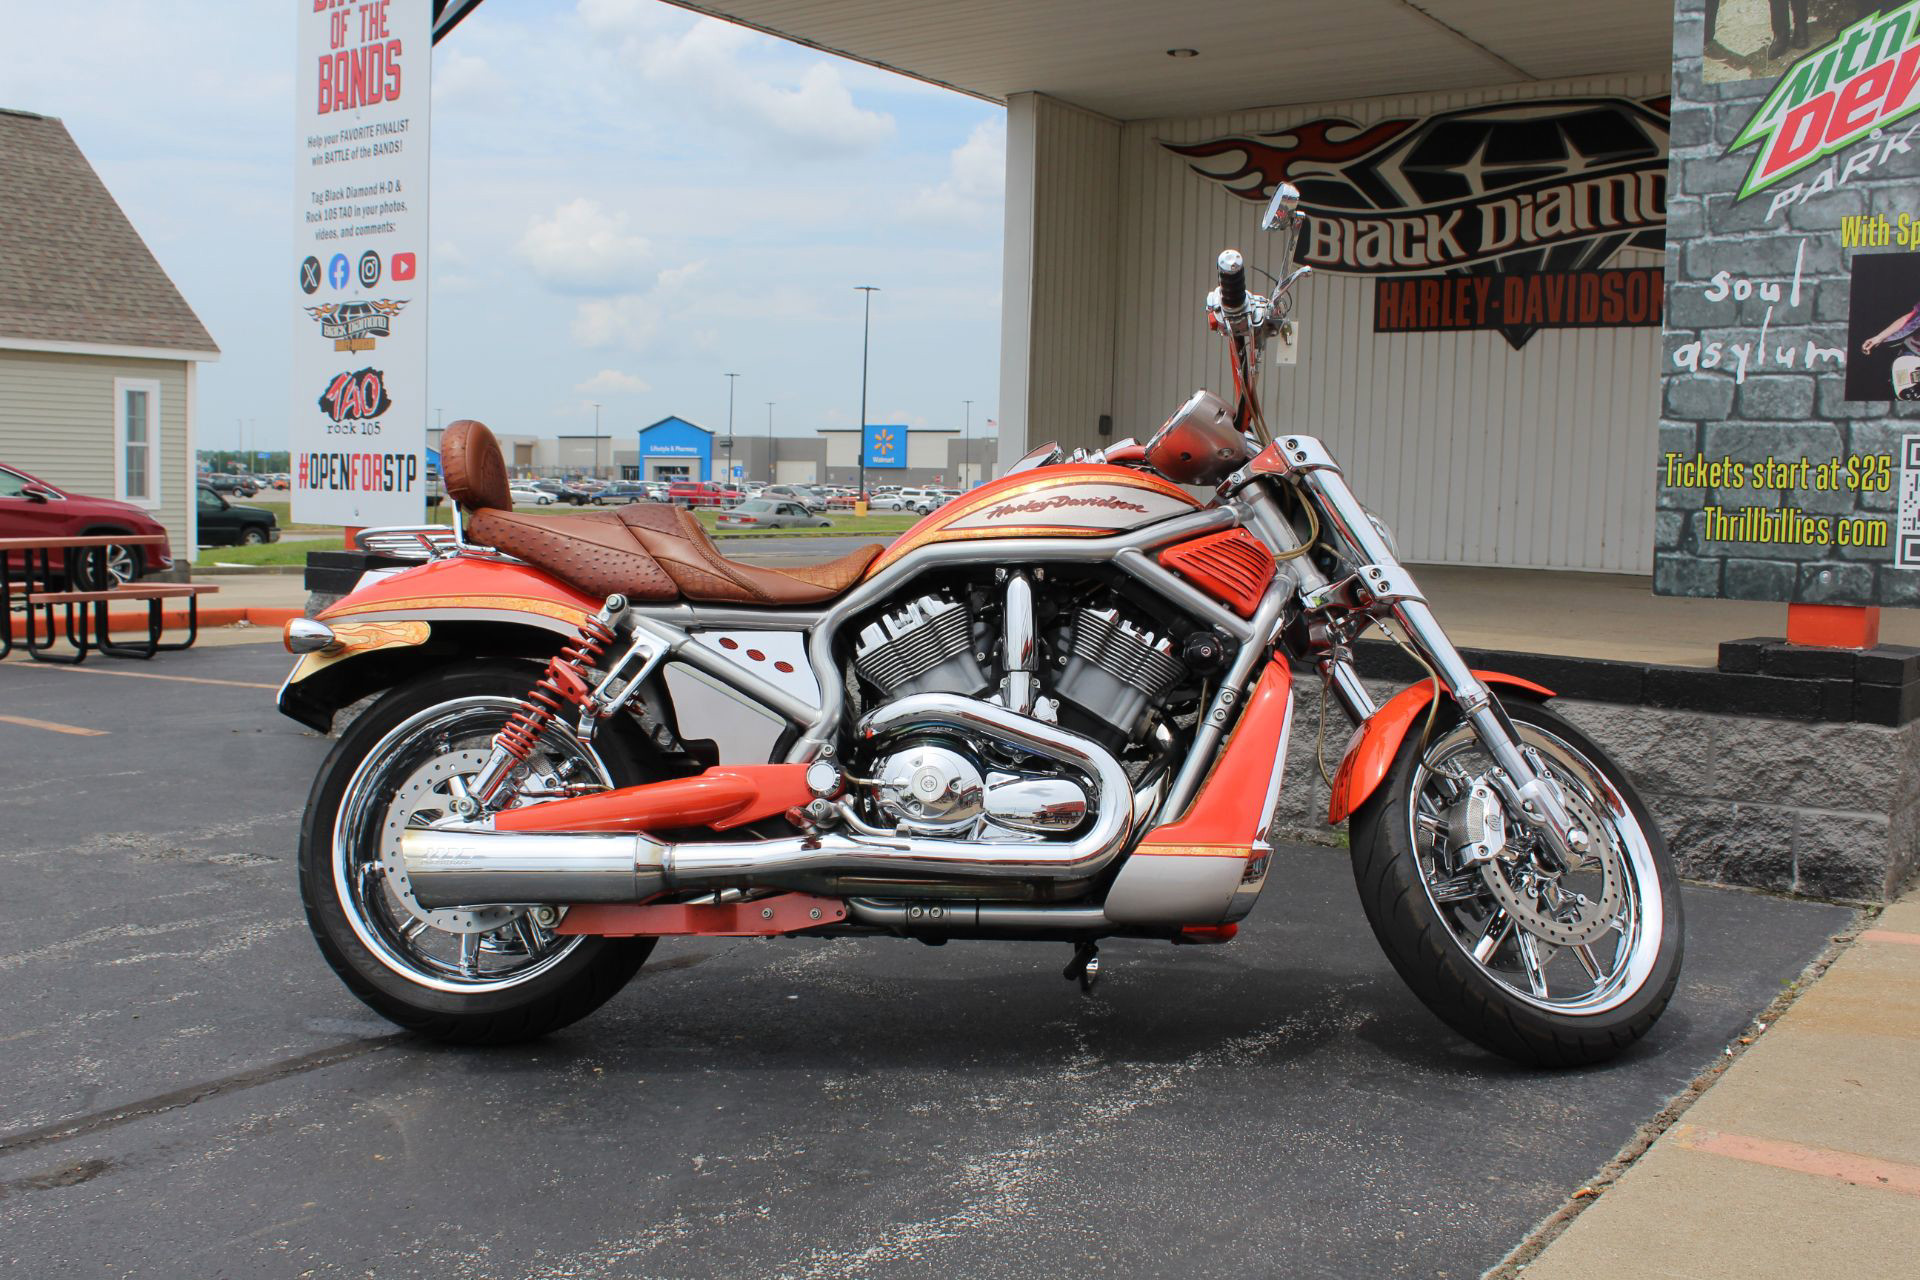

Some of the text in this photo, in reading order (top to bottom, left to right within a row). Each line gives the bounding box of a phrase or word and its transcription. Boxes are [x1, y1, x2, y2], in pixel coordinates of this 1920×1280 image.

[331, 0, 390, 49] OF THE
[317, 38, 402, 115] BANDS
[1761, 11, 1912, 125] Mtn
[307, 119, 409, 149] Help your FAVORITE FINALIST
[312, 139, 403, 166] win BATTLE of the BANDS!
[311, 179, 402, 205] Tag Black Diamond H-D &
[1764, 123, 1920, 223] PARK
[306, 210, 322, 223] Rock
[324, 207, 337, 221] 105
[339, 205, 353, 219] TAO
[354, 204, 361, 217] in
[362, 204, 378, 219] your
[340, 224, 354, 238] and
[1841, 213, 1890, 248] With
[1673, 306, 1845, 384] asylum
[327, 421, 381, 435] rock 105
[298, 453, 416, 492] #OPENFORSTP
[1665, 453, 1891, 493] Tickets start at $25
[1704, 506, 1888, 547] Thrillbillies.com
